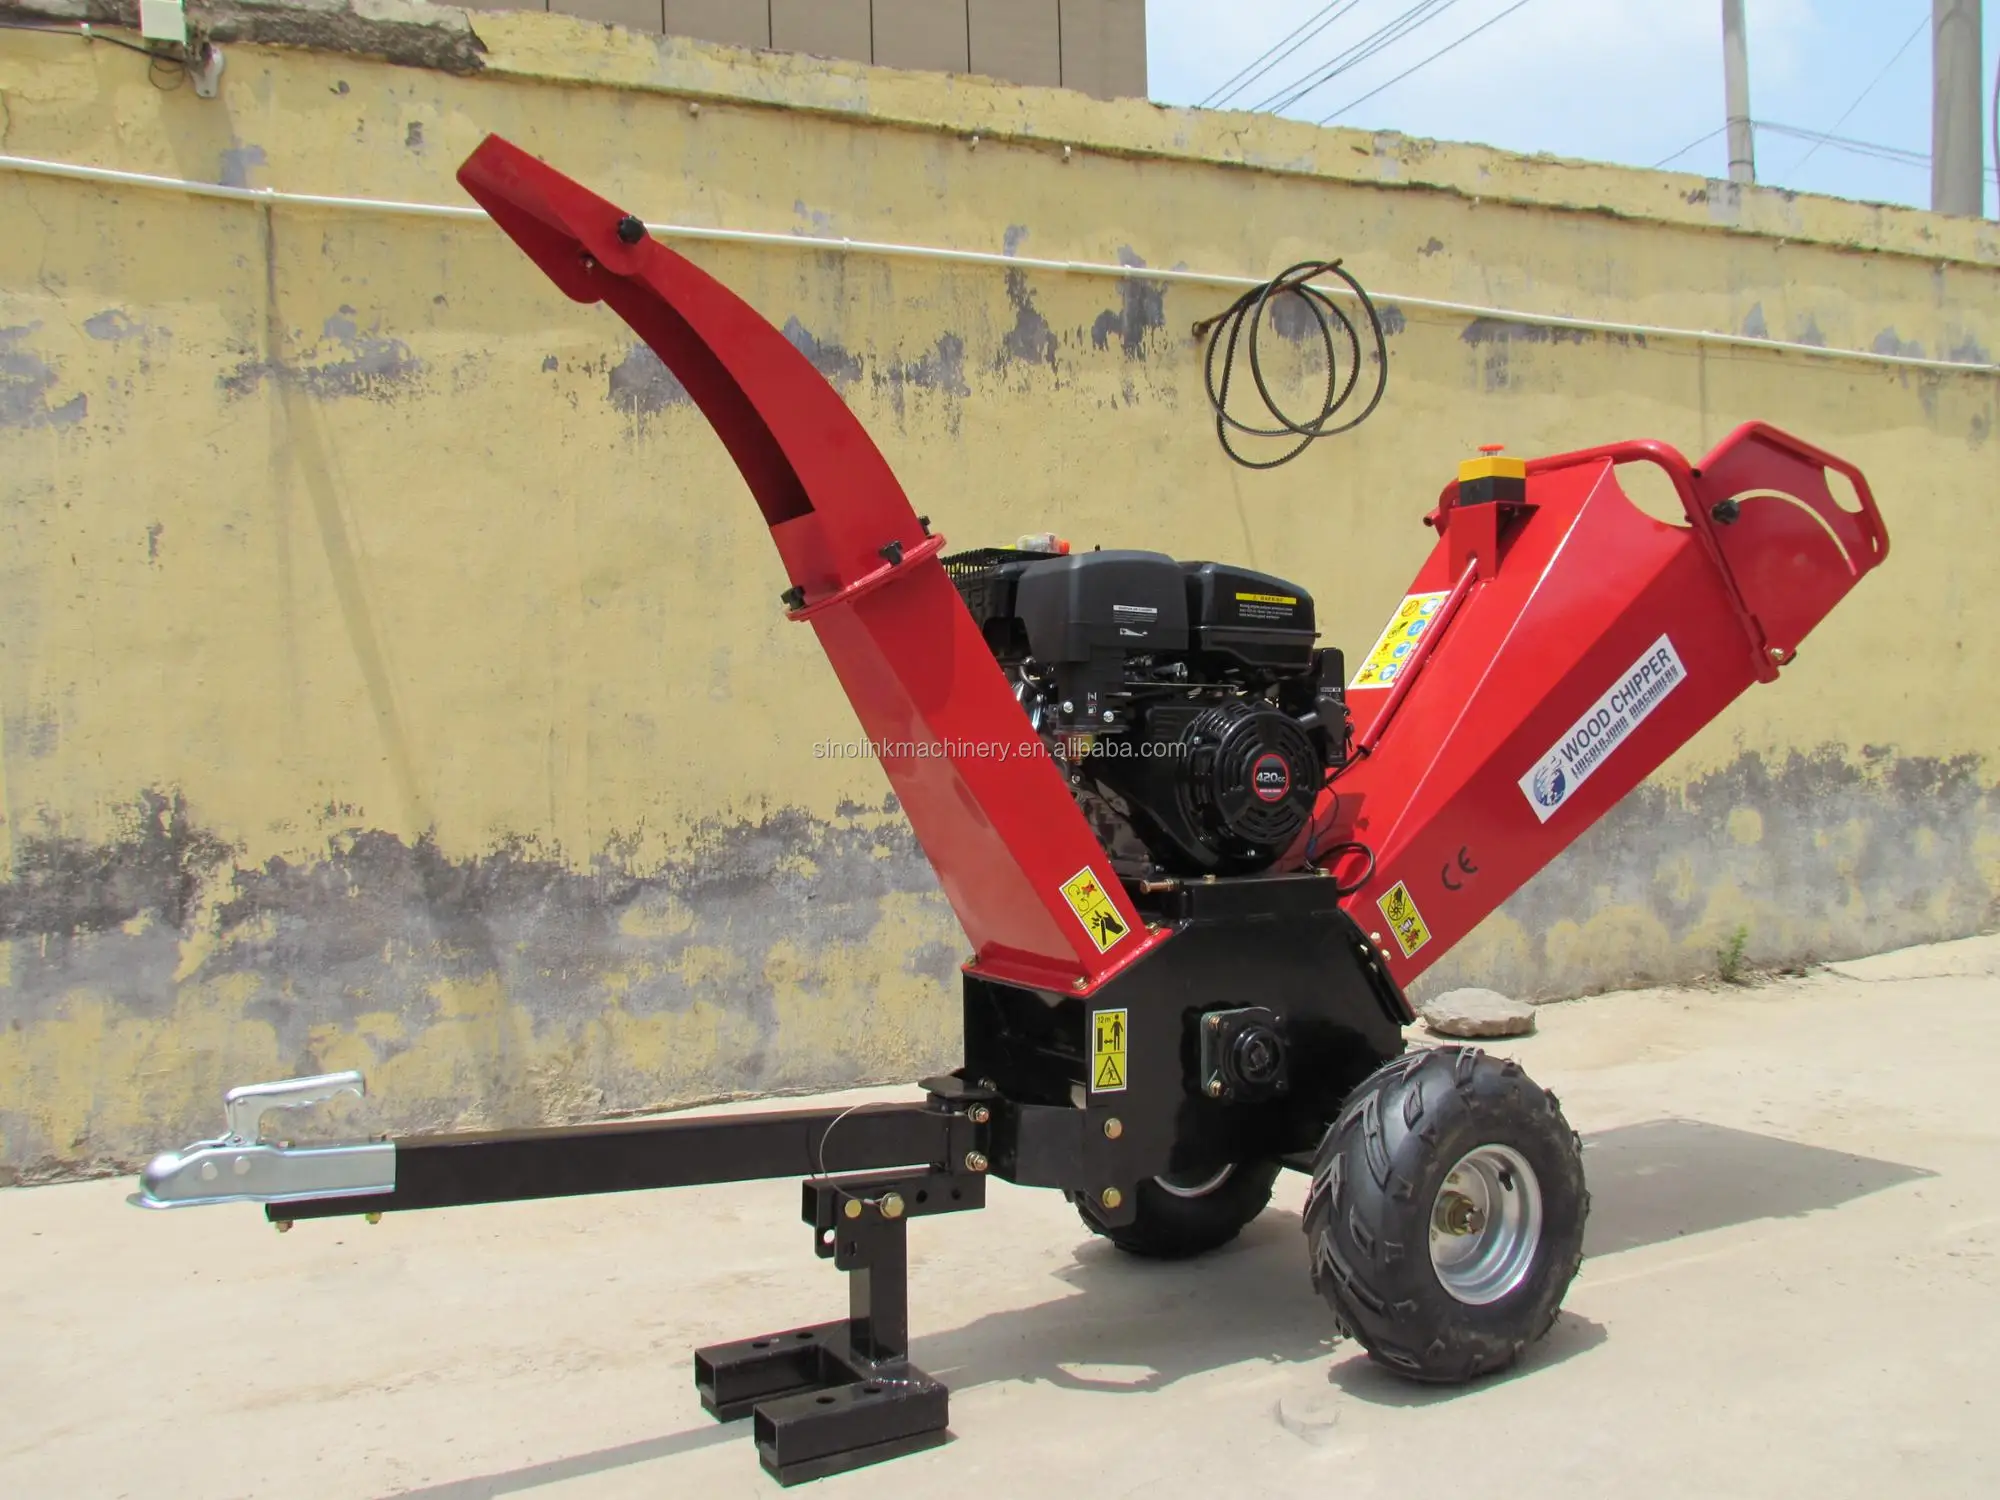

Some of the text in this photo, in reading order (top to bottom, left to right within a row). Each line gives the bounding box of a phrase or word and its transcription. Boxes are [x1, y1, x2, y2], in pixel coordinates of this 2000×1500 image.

[1560, 648, 1672, 763] WOOD CHIPPER
[1441, 846, 1478, 891] CE
